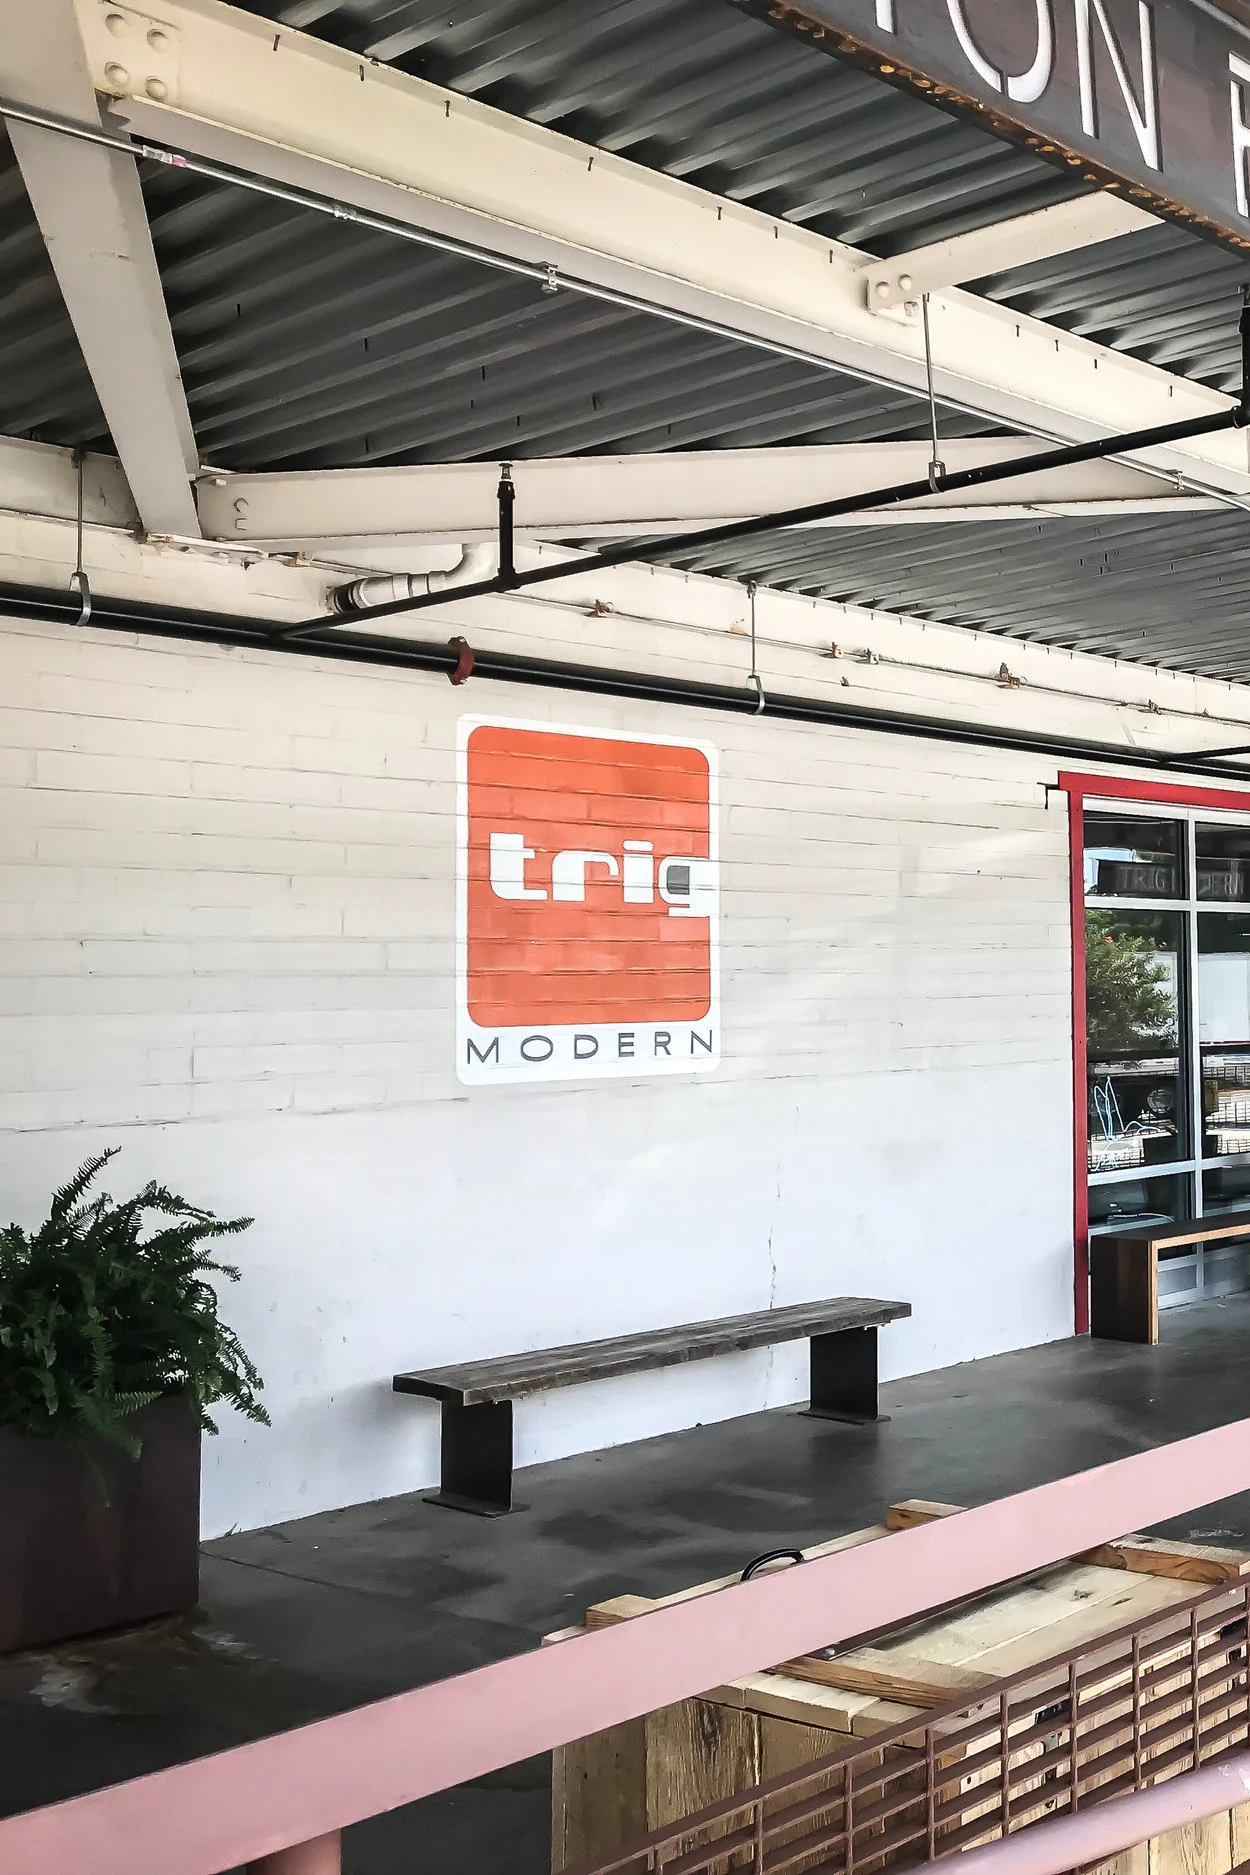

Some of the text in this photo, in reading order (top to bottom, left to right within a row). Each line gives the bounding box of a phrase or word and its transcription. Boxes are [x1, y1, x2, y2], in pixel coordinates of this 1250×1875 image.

[876, 0, 1163, 172] ON
[489, 832, 712, 917] trig
[467, 1029, 713, 1065] MODERN
